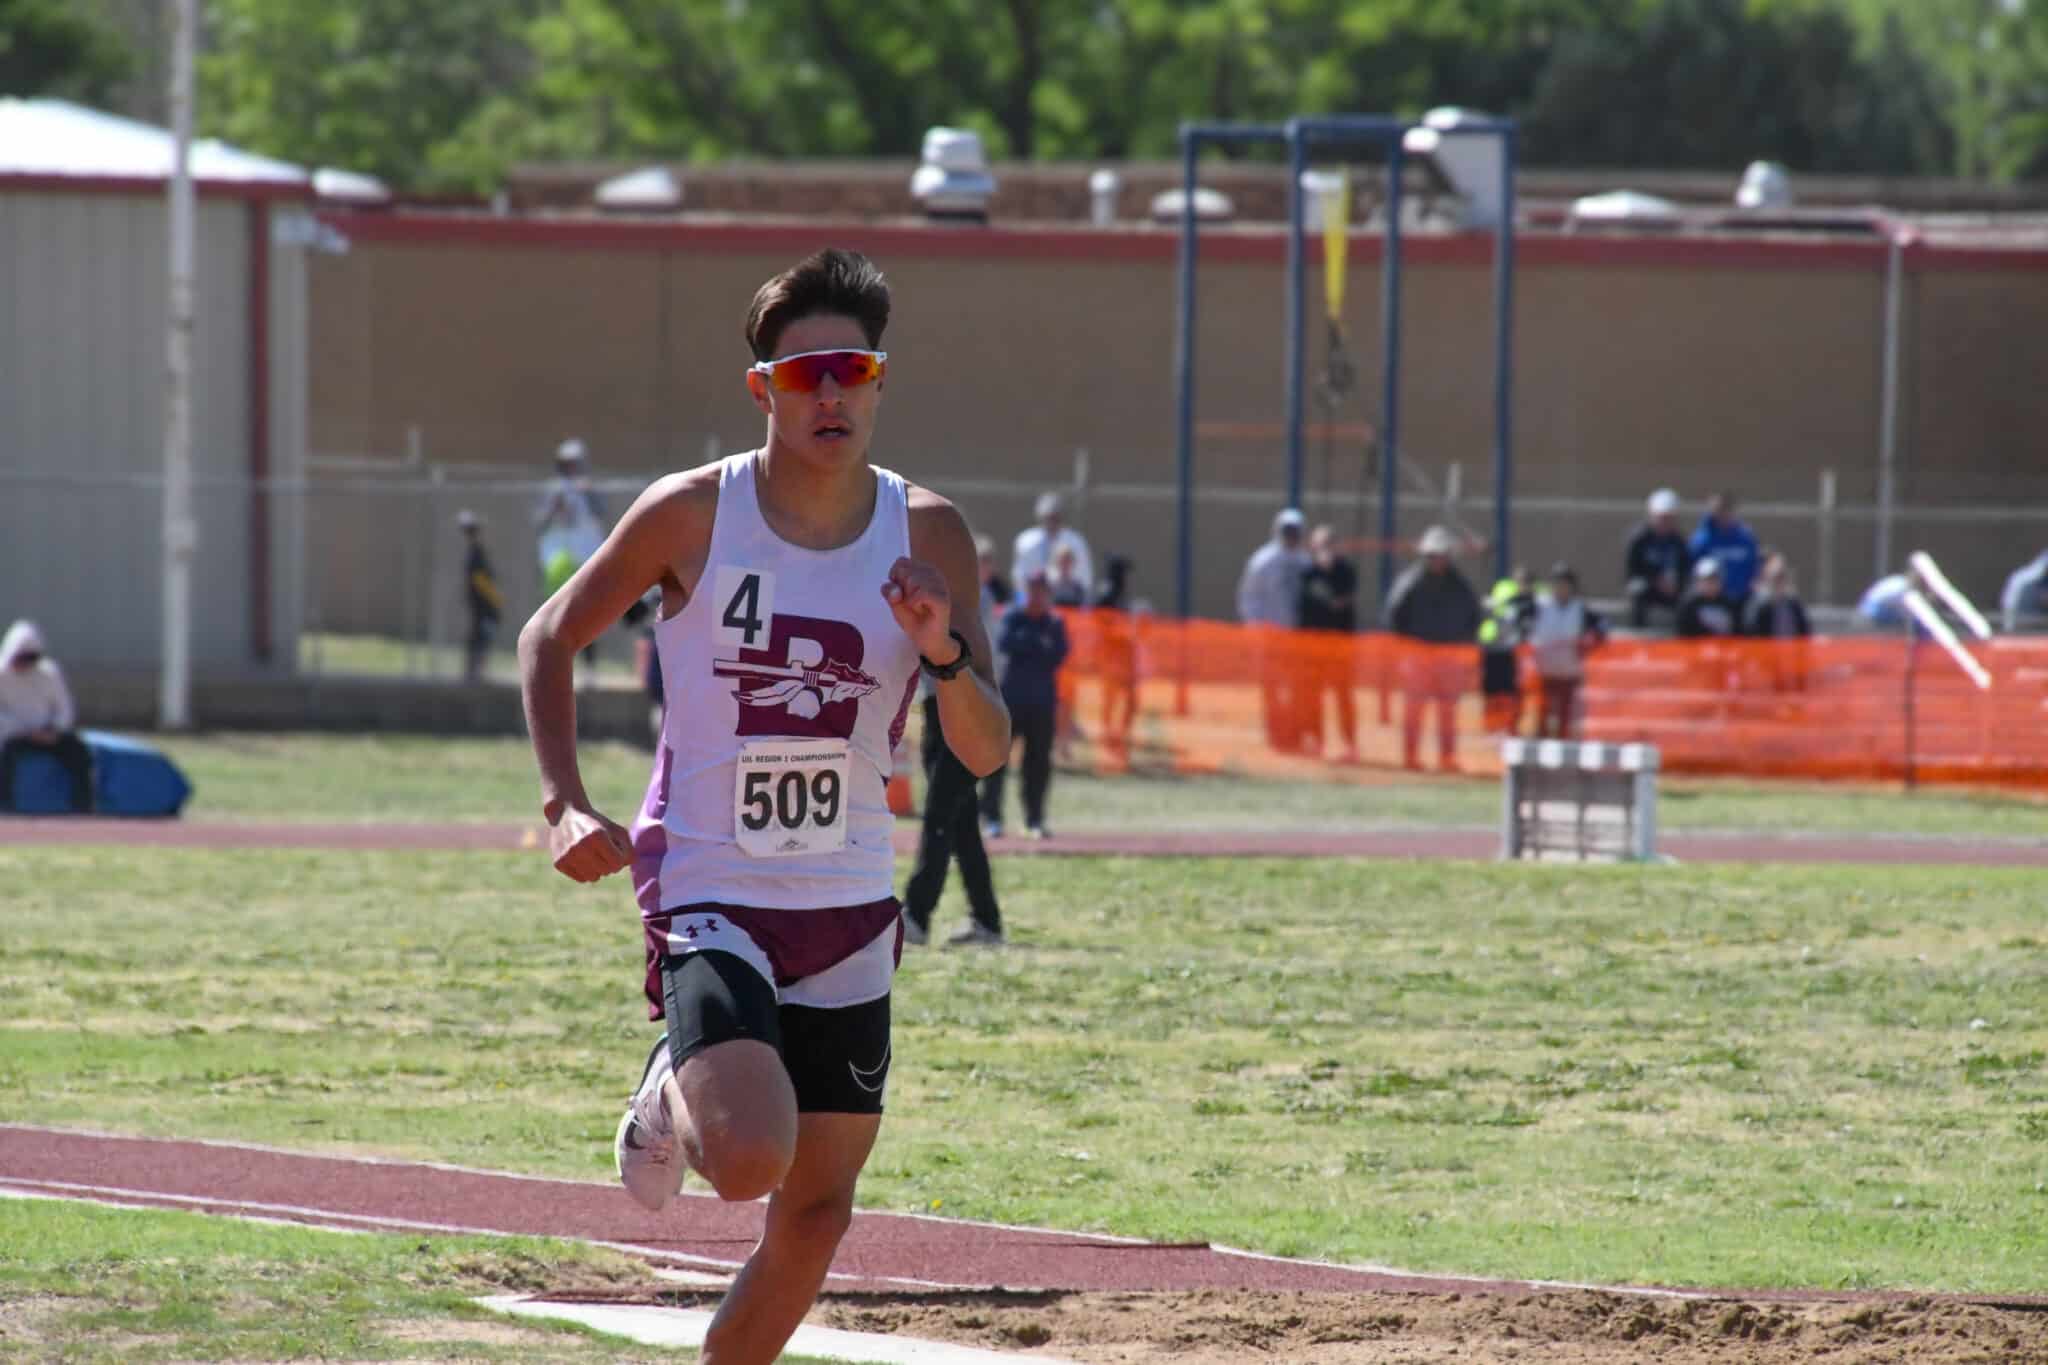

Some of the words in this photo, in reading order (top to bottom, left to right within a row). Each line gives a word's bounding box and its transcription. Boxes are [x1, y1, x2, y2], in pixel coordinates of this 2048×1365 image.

[722, 573, 762, 645] 4
[790, 751, 847, 763] CHAMPIONSHIPS
[741, 769, 840, 831] 509
